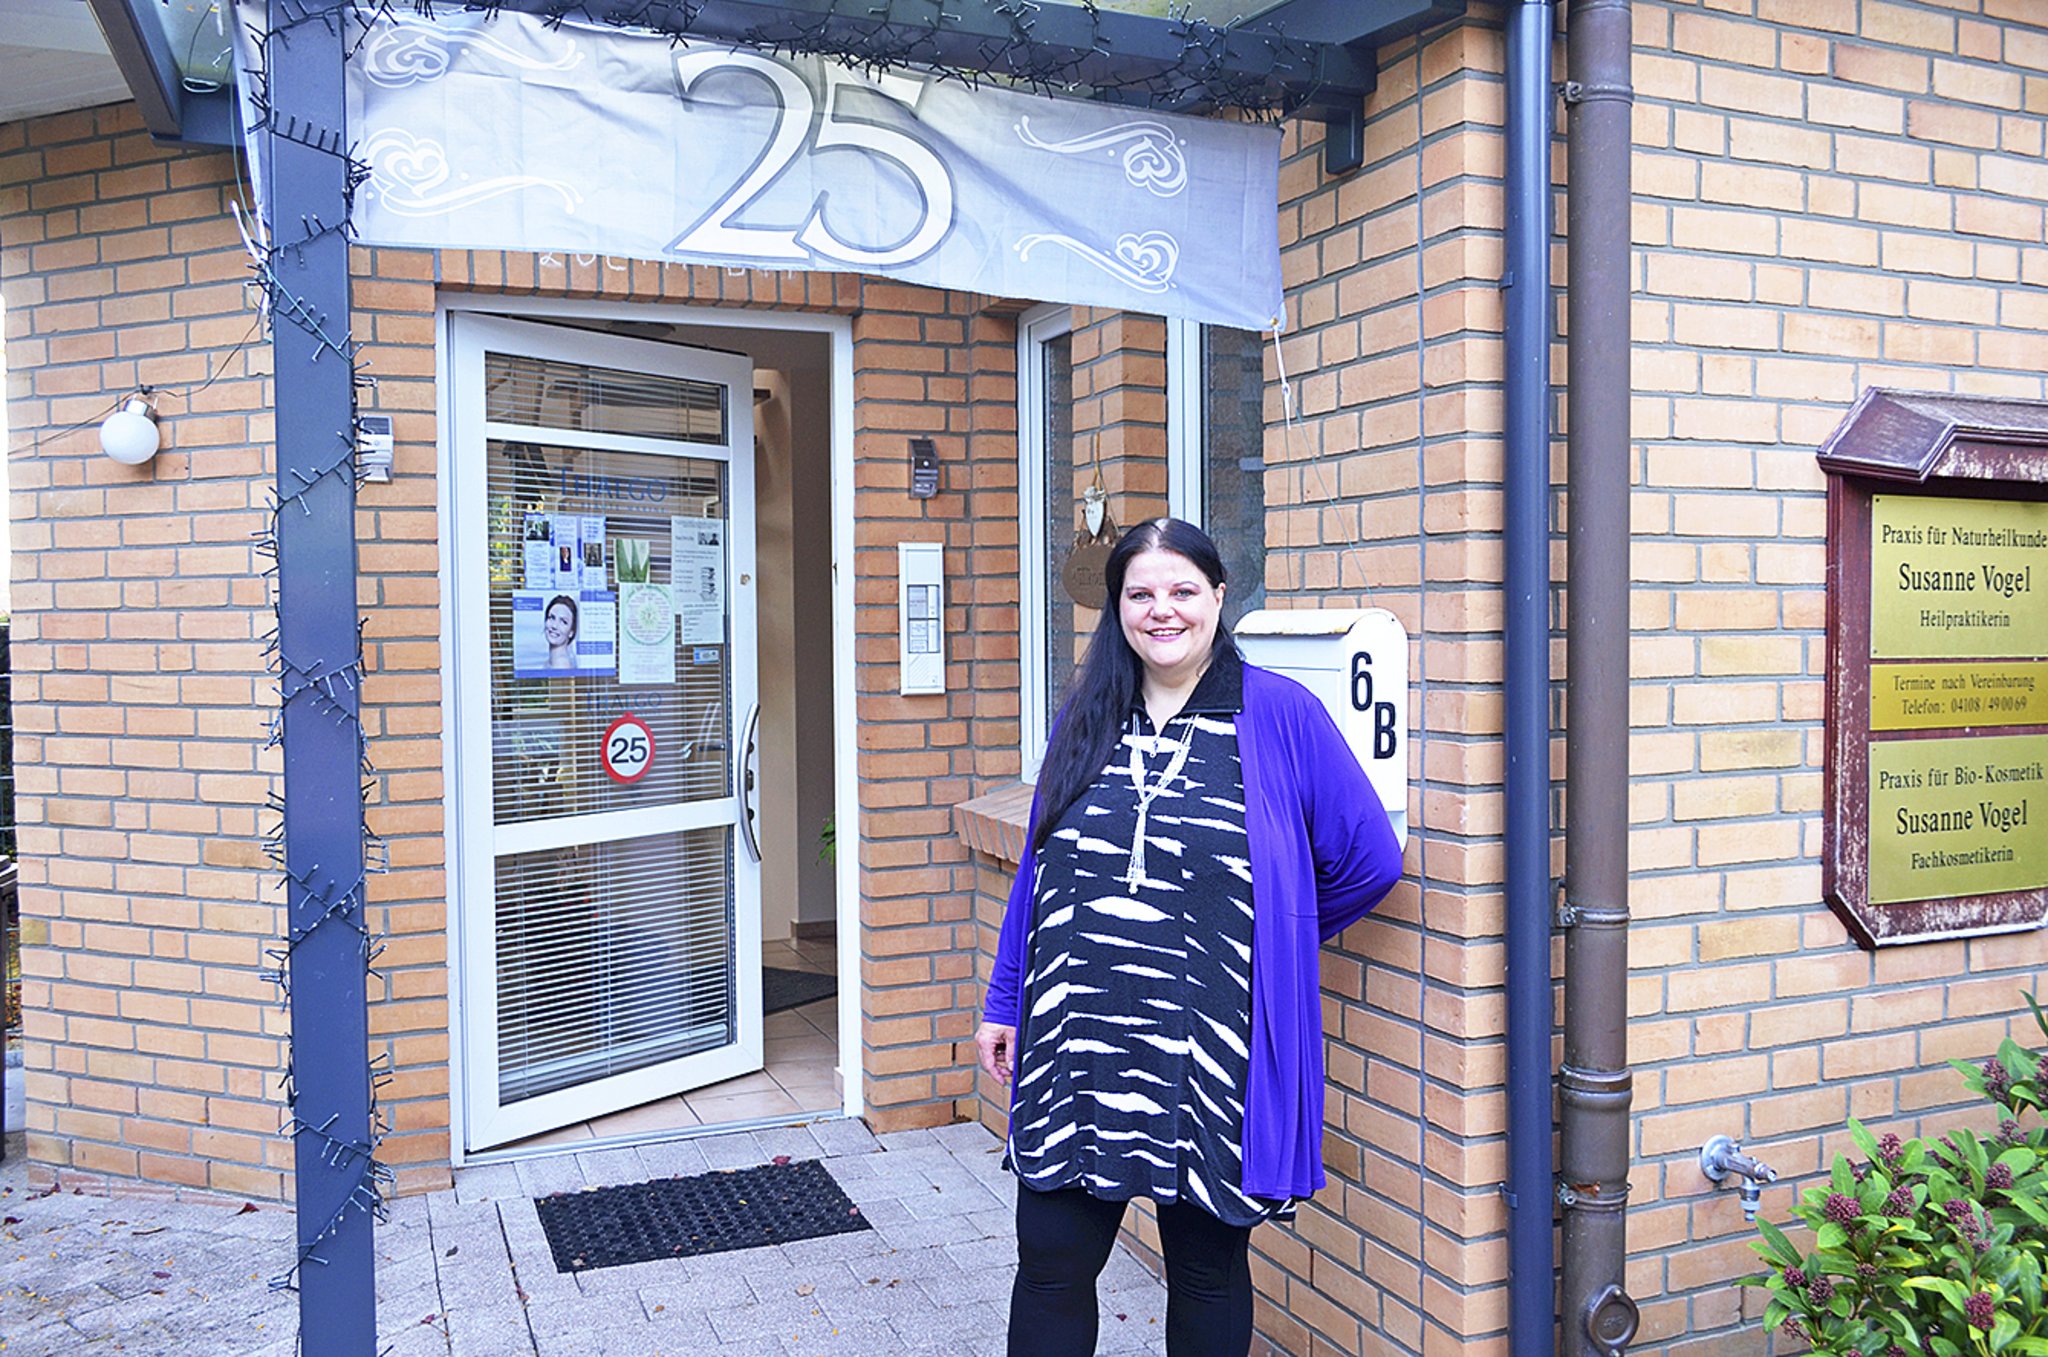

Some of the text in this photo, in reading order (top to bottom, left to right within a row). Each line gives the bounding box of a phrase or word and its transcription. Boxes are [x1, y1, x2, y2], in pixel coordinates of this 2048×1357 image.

[662, 48, 958, 271] 25
[1882, 524, 2048, 548] Praxis für Naturheilkunde
[1899, 562, 2031, 598] Susanne Vogel
[1920, 610, 2010, 630] Heilpraktikerin
[1893, 673, 2035, 692] Termine nach Vereinbarung
[1351, 651, 1397, 760] 6 B
[1902, 698, 1946, 715] Telefon:
[611, 737, 648, 764] 25
[1879, 769, 1922, 790] Praxis
[1927, 768, 1949, 787] für
[1896, 799, 2028, 835] Susanne Vogel
[1911, 845, 2014, 870] Fachkosmetikerin
